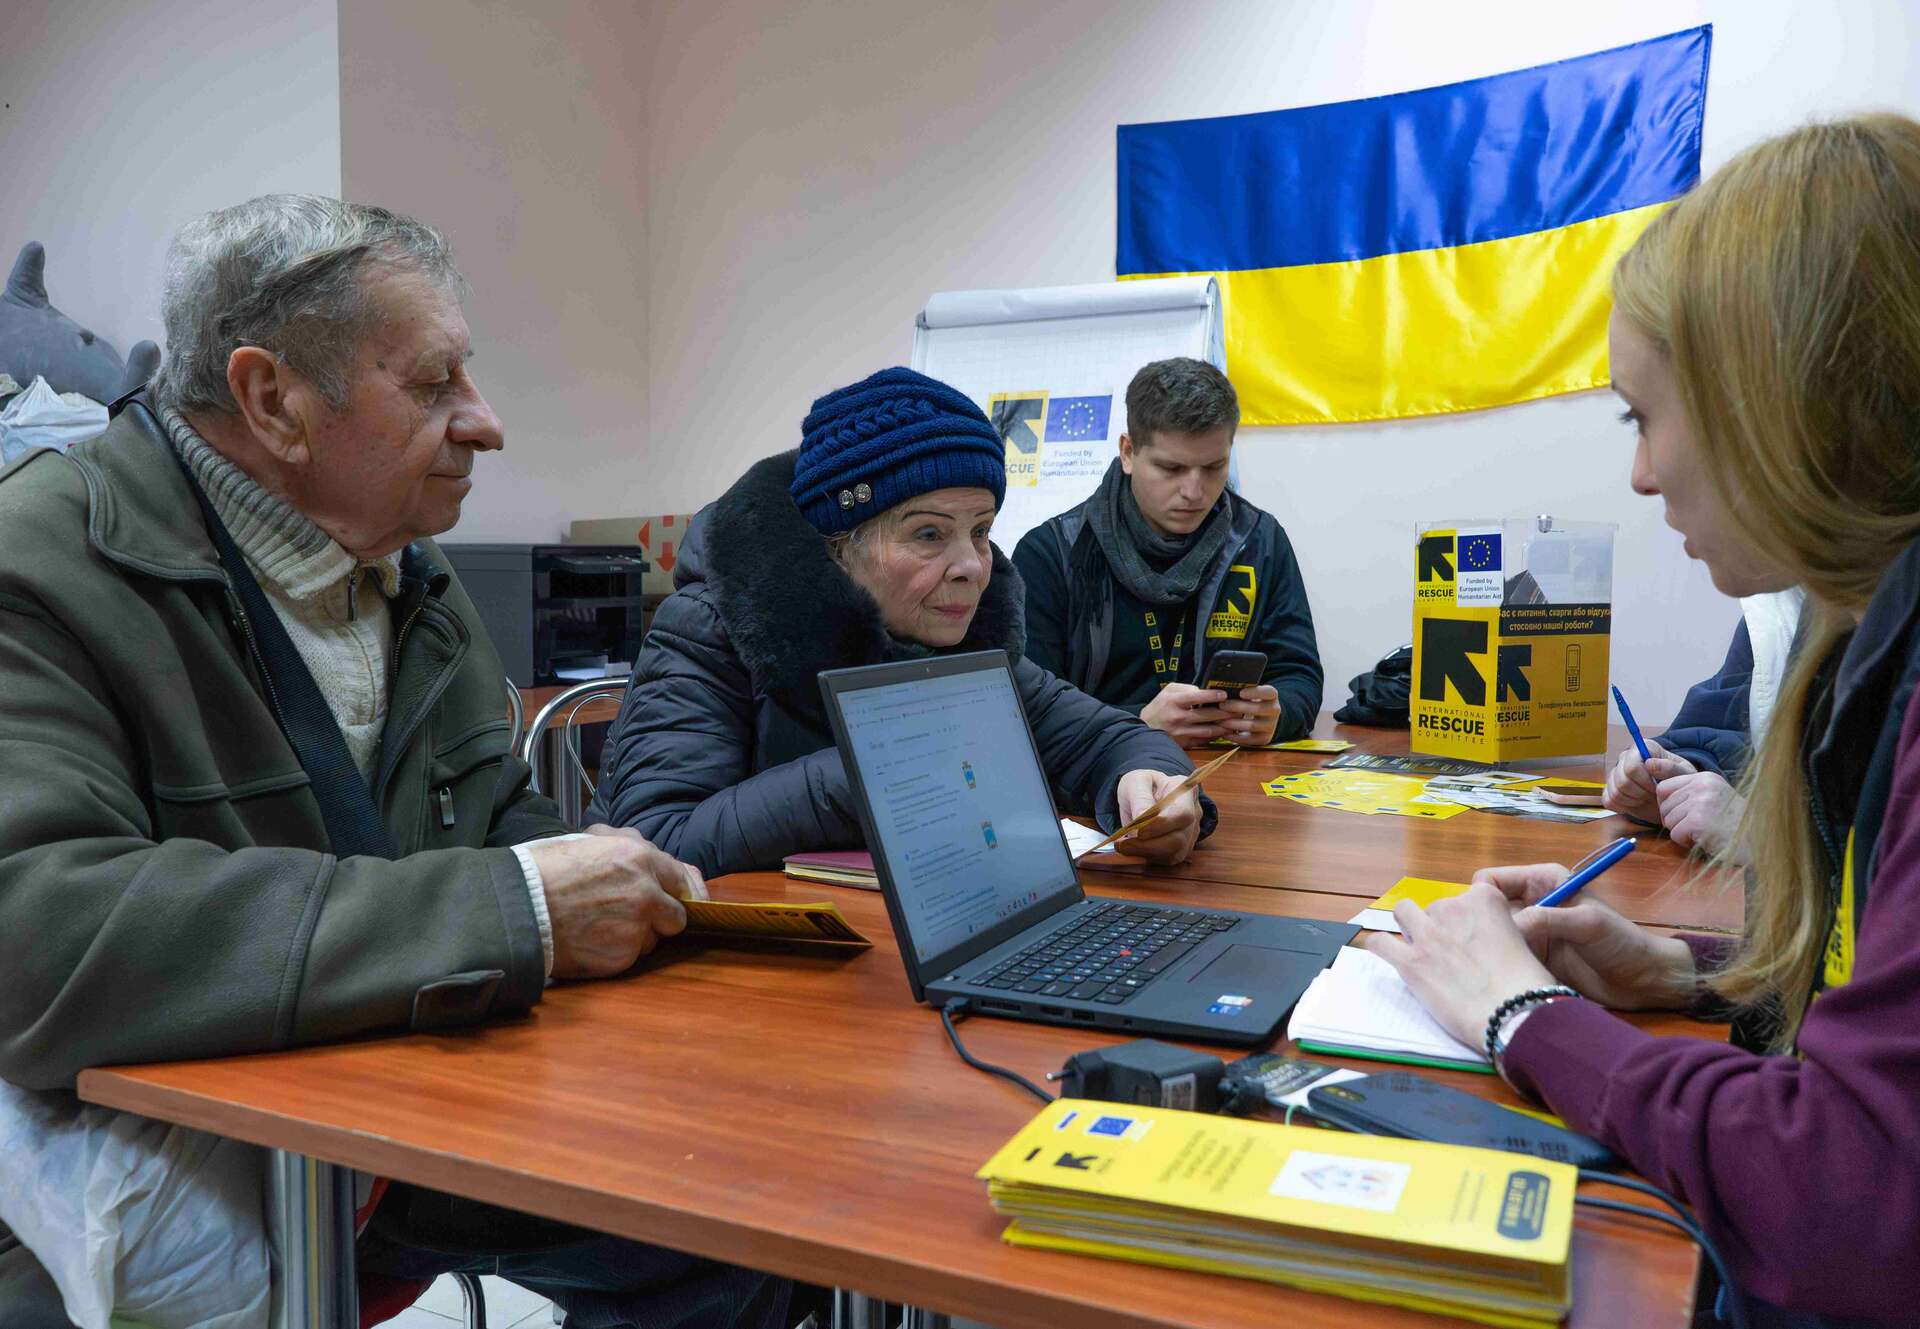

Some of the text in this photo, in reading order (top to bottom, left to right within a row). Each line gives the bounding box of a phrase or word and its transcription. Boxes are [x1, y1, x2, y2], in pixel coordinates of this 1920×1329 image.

[1083, 449, 1094, 459] by
[1043, 459, 1104, 470] European Union
[1486, 577, 1493, 585] by
[1418, 589, 1454, 598] RESCUE
[1419, 705, 1486, 719] INTERNATIONAL
[1495, 711, 1530, 722] ESCUE
[1418, 713, 1485, 736] RESCUE
[1418, 729, 1485, 745] COMMITTEE
